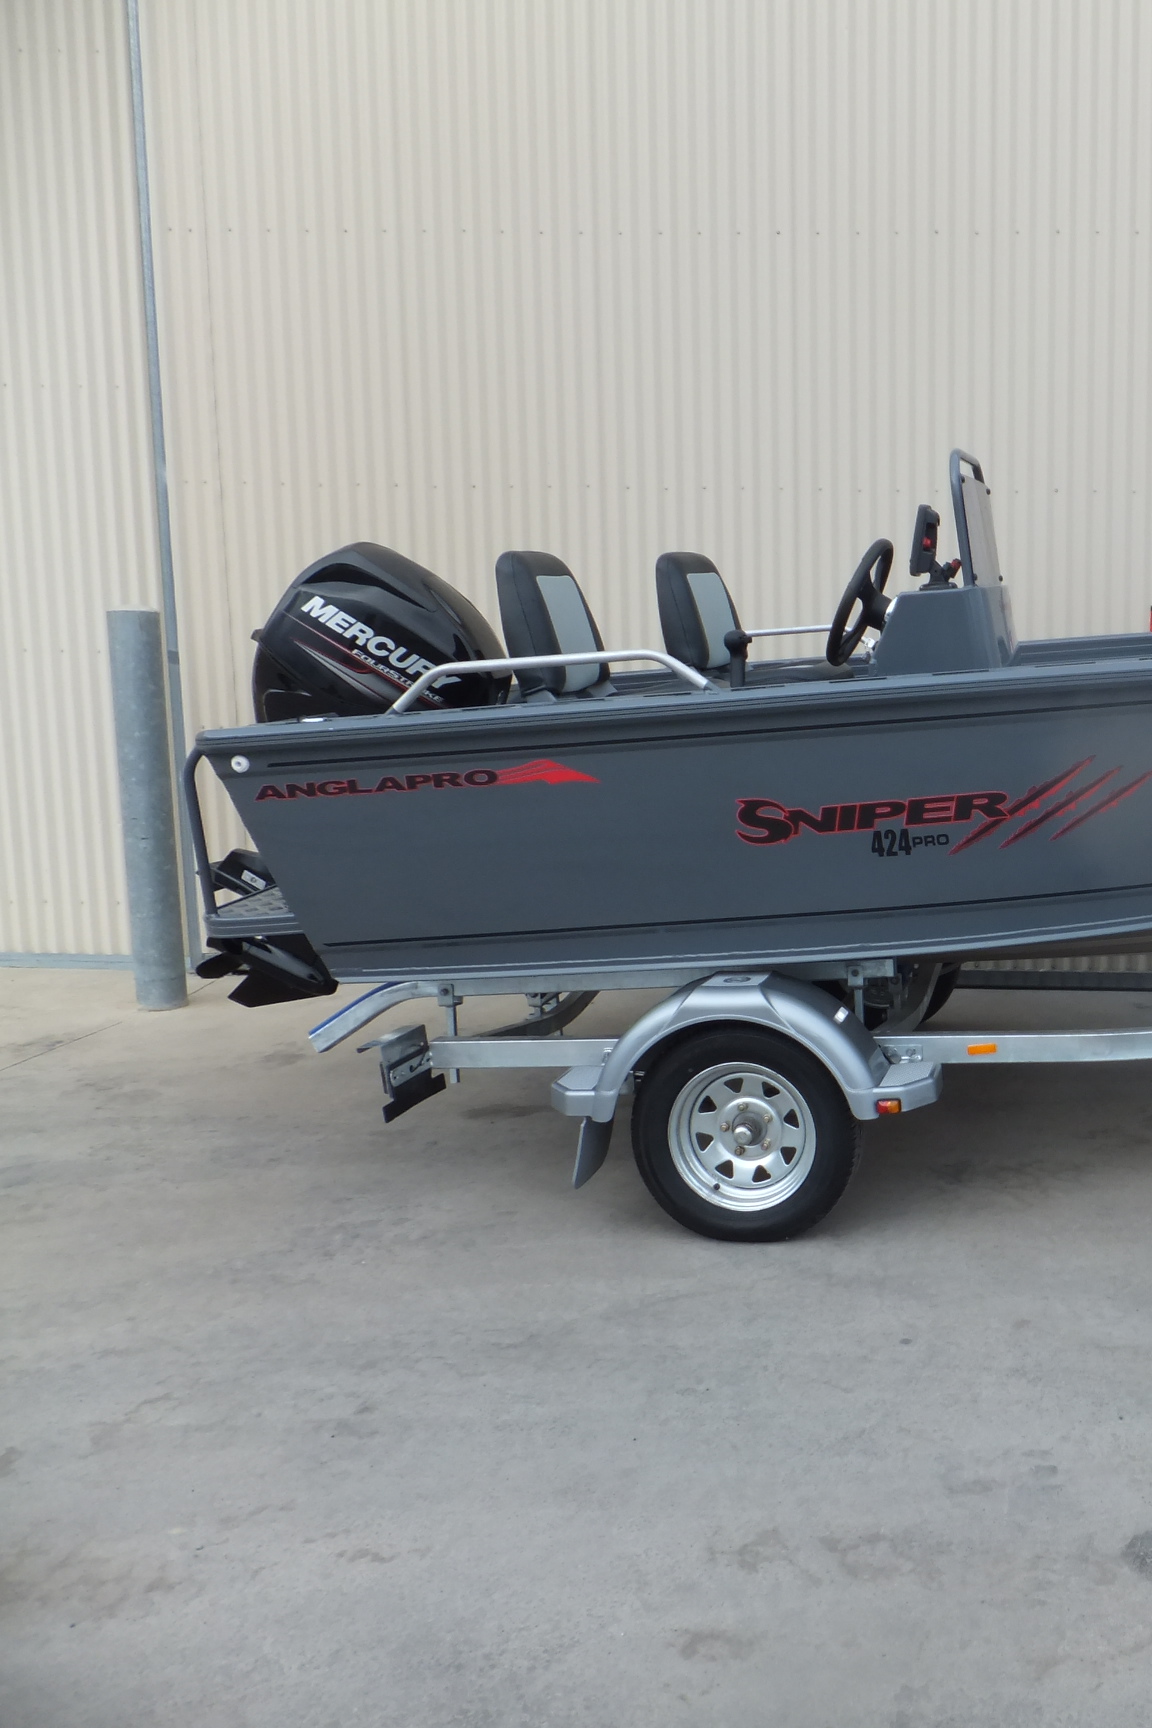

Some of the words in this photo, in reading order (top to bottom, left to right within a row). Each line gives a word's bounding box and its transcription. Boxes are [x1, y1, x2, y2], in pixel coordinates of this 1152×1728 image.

[301, 596, 462, 689] MERCURY
[351, 648, 446, 703] FOURSTRKE
[255, 768, 499, 802] ANGLAPRO
[735, 790, 1009, 846] SNIPER
[871, 829, 912, 858] 424
[912, 832, 950, 849] PRO
